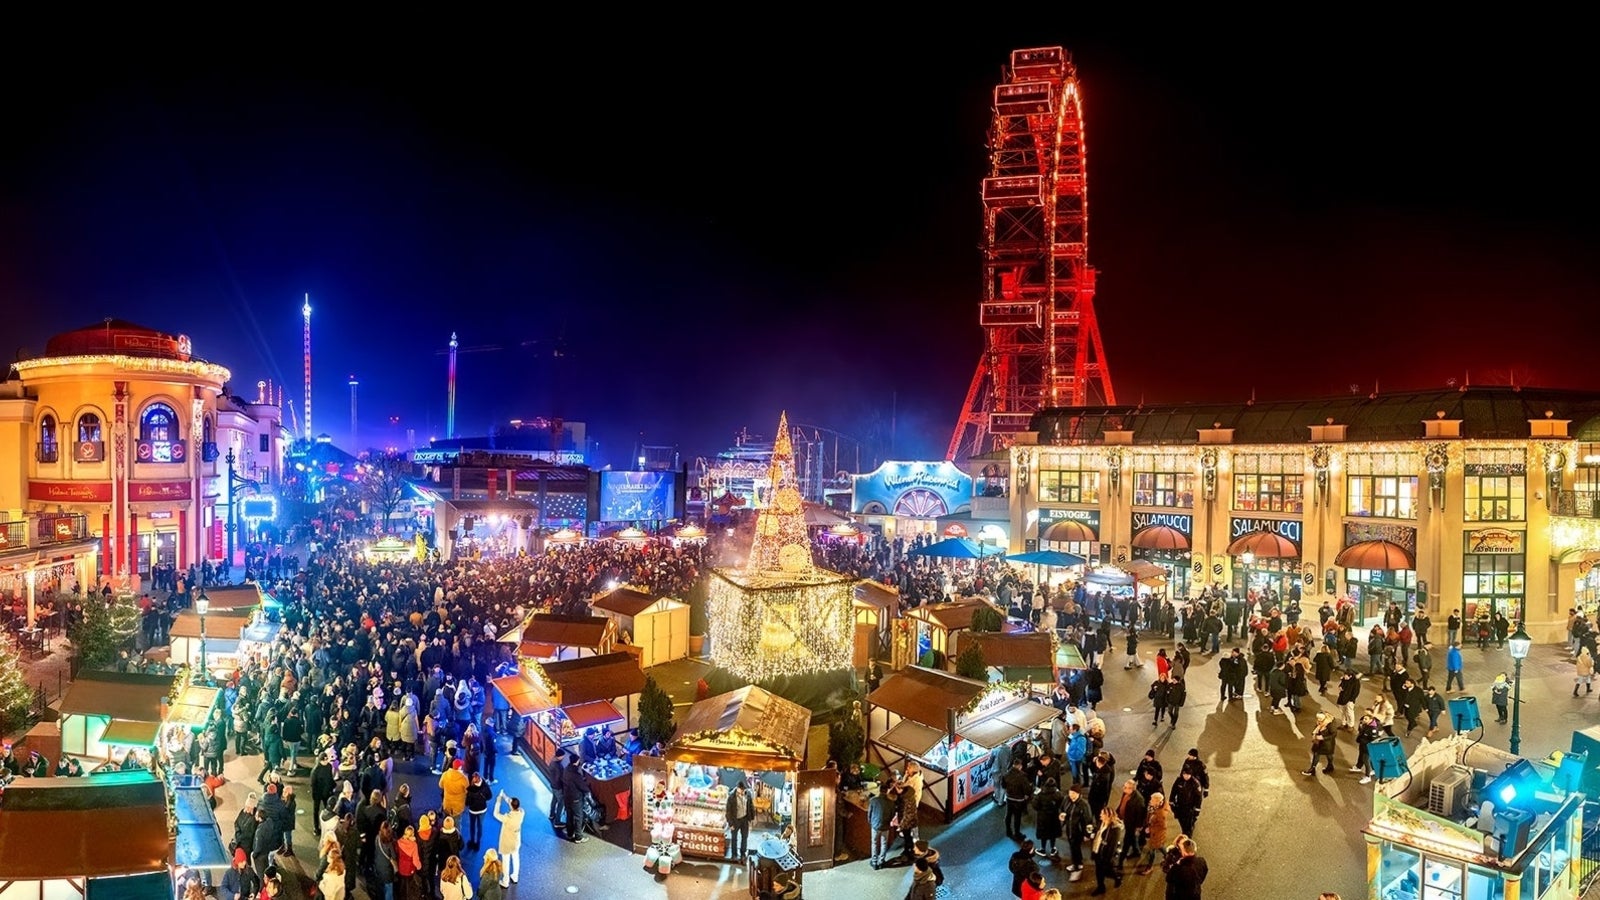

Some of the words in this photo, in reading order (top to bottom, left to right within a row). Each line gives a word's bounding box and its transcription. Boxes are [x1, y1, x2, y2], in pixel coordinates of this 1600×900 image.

[884, 474, 917, 490] Wiener
[914, 471, 960, 490] Riesenrad
[49, 486, 68, 496] Madame
[69, 487, 94, 498] Tussauds
[1049, 510, 1091, 519] EISVOGEL
[1133, 513, 1190, 533] SALAMUCCI
[1232, 518, 1300, 541] SALAMUCCI
[676, 830, 719, 843] Schoko
[676, 839, 719, 852] Früchte
